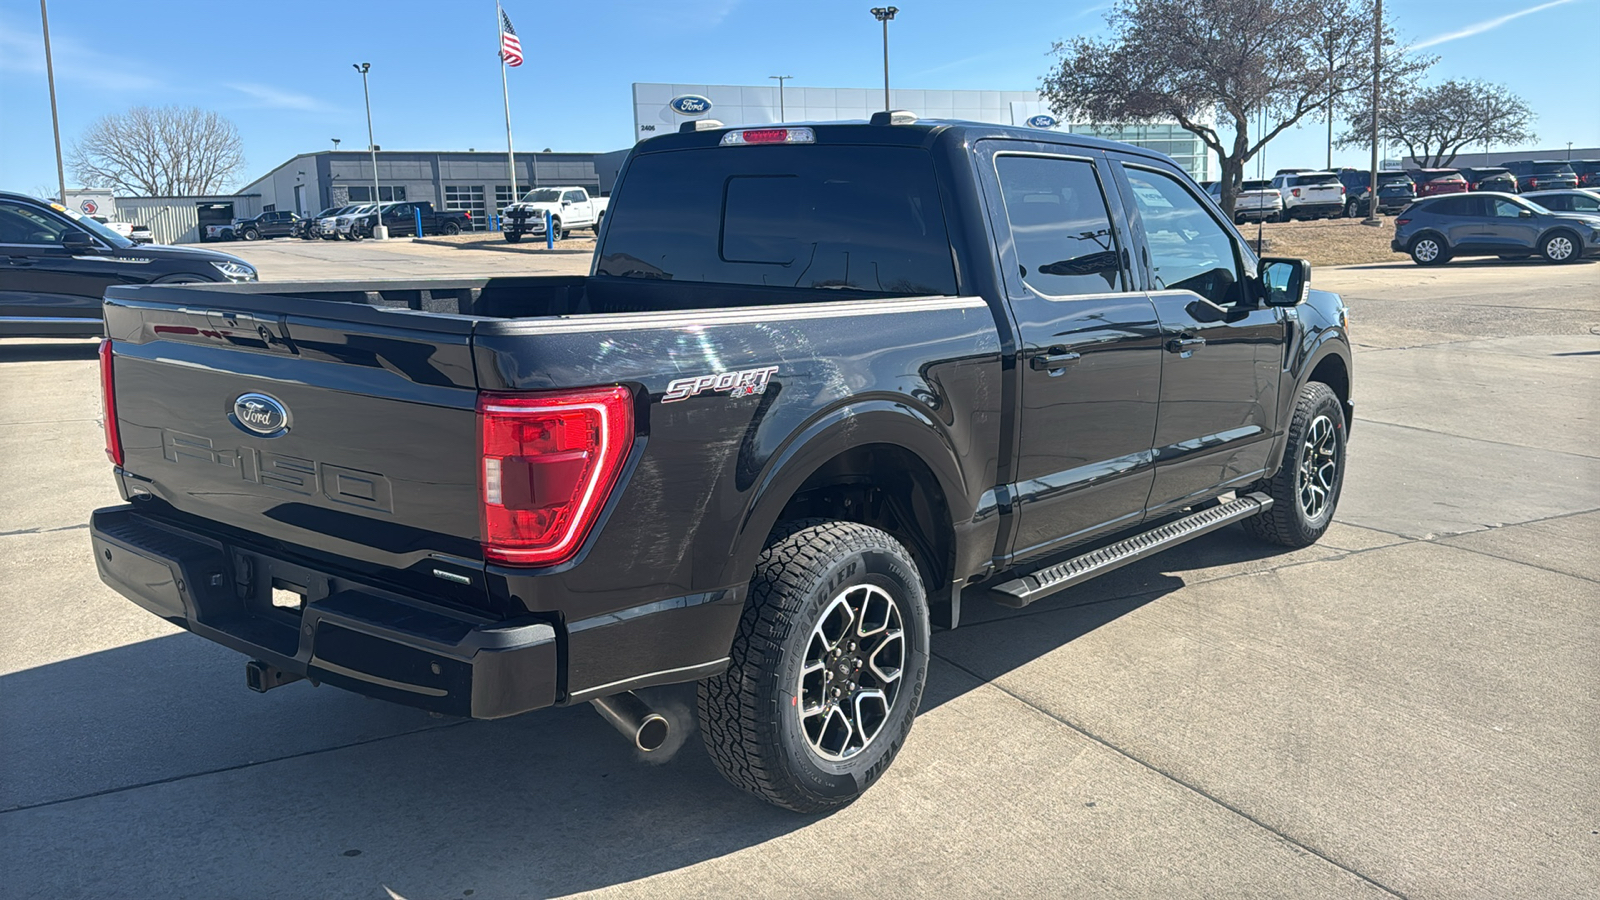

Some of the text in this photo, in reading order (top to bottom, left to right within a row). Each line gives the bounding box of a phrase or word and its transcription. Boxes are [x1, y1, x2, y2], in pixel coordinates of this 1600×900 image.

[680, 99, 705, 112] Ford
[1035, 116, 1051, 126] Ford
[661, 365, 779, 403] SPORT
[243, 401, 272, 425] Ford
[160, 427, 394, 514] F-150
[786, 561, 858, 682] WRANGLER
